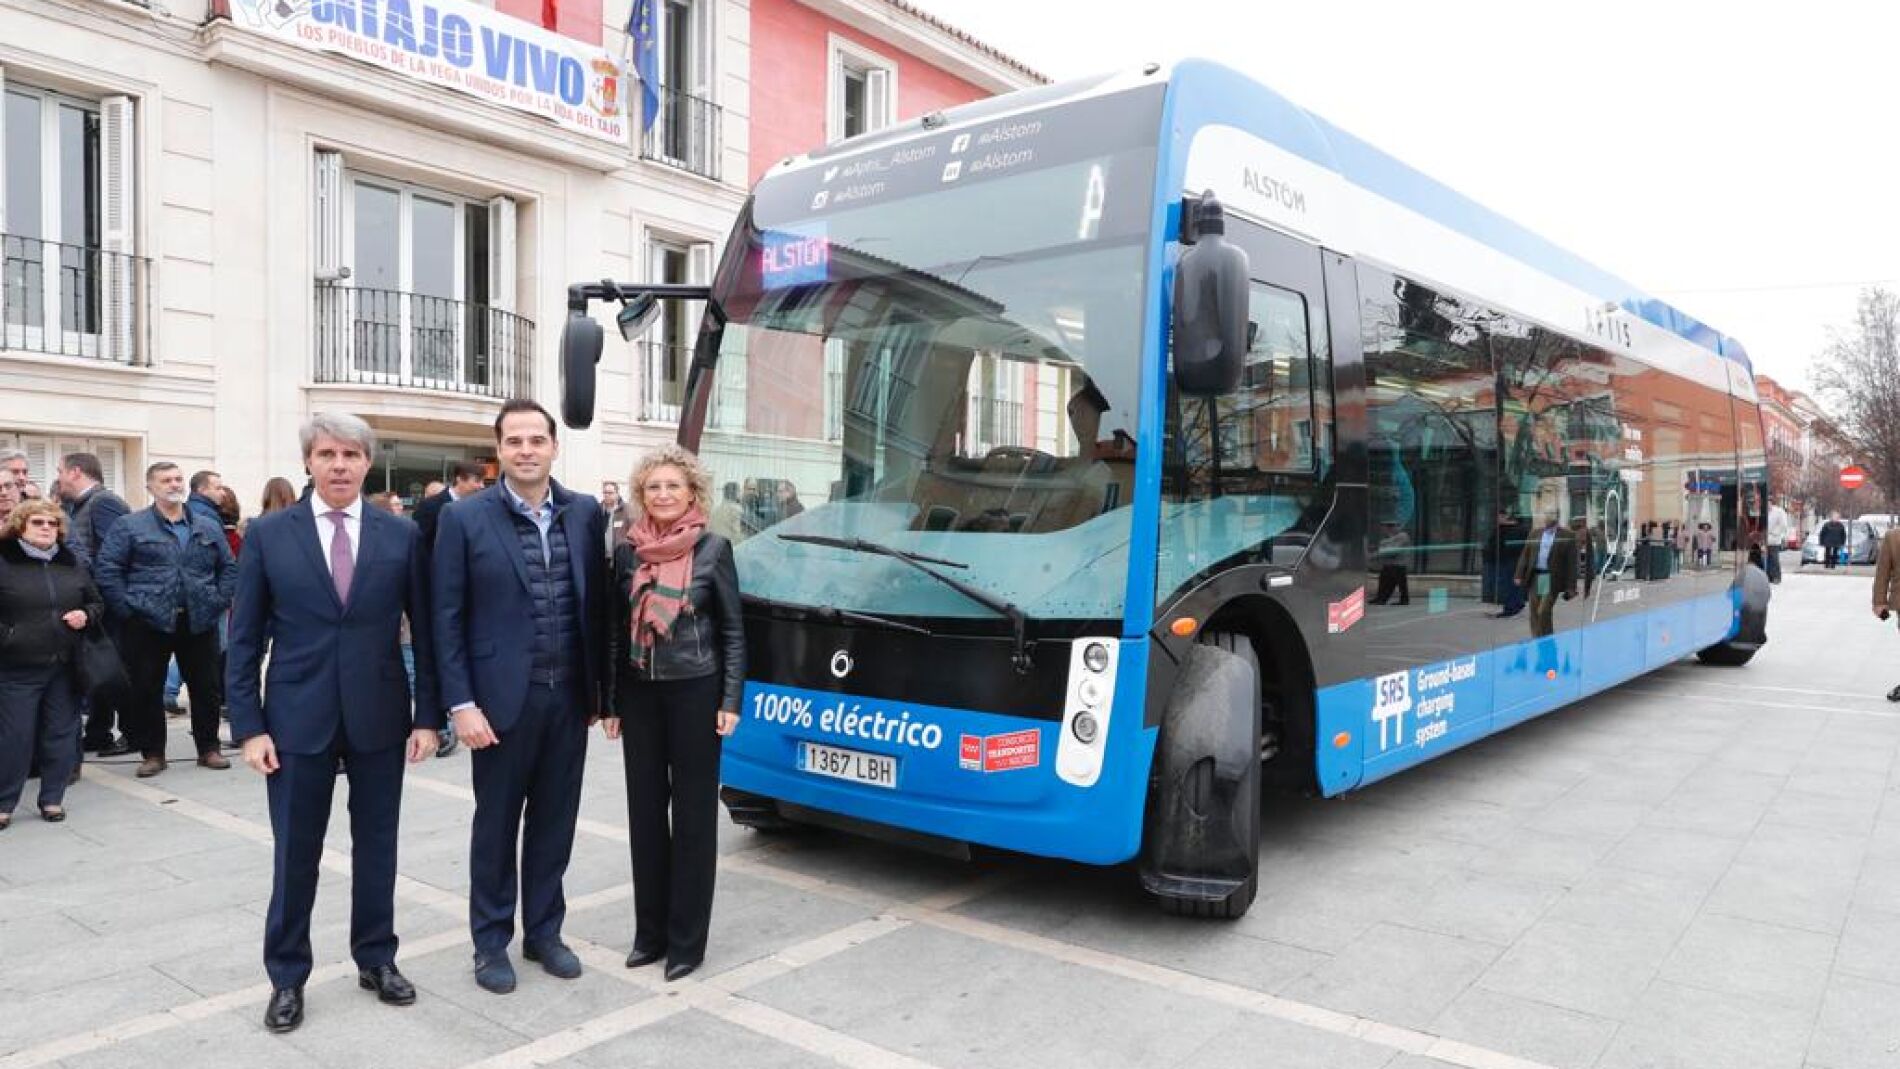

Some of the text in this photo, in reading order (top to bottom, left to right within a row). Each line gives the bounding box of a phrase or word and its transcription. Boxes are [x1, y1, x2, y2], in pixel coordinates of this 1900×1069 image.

[361, 0, 473, 68] TAJO
[480, 25, 585, 106] VIVO
[297, 20, 323, 42] LOS
[328, 28, 387, 61] PUEBLOS
[391, 49, 405, 67] DE
[409, 57, 426, 75] LA
[430, 63, 461, 83] VEGA
[465, 73, 506, 99] UNIDOS
[510, 88, 534, 105] POR
[537, 96, 550, 111] LA
[576, 110, 595, 129] DEL
[597, 118, 621, 137] TAJO
[1381, 675, 1404, 707] SRS
[1417, 655, 1475, 692] Ground-based
[754, 692, 943, 750] 100% eléctrico
[1417, 688, 1454, 718] charging
[1415, 719, 1447, 748] system
[810, 747, 893, 784] 1367 LBH
